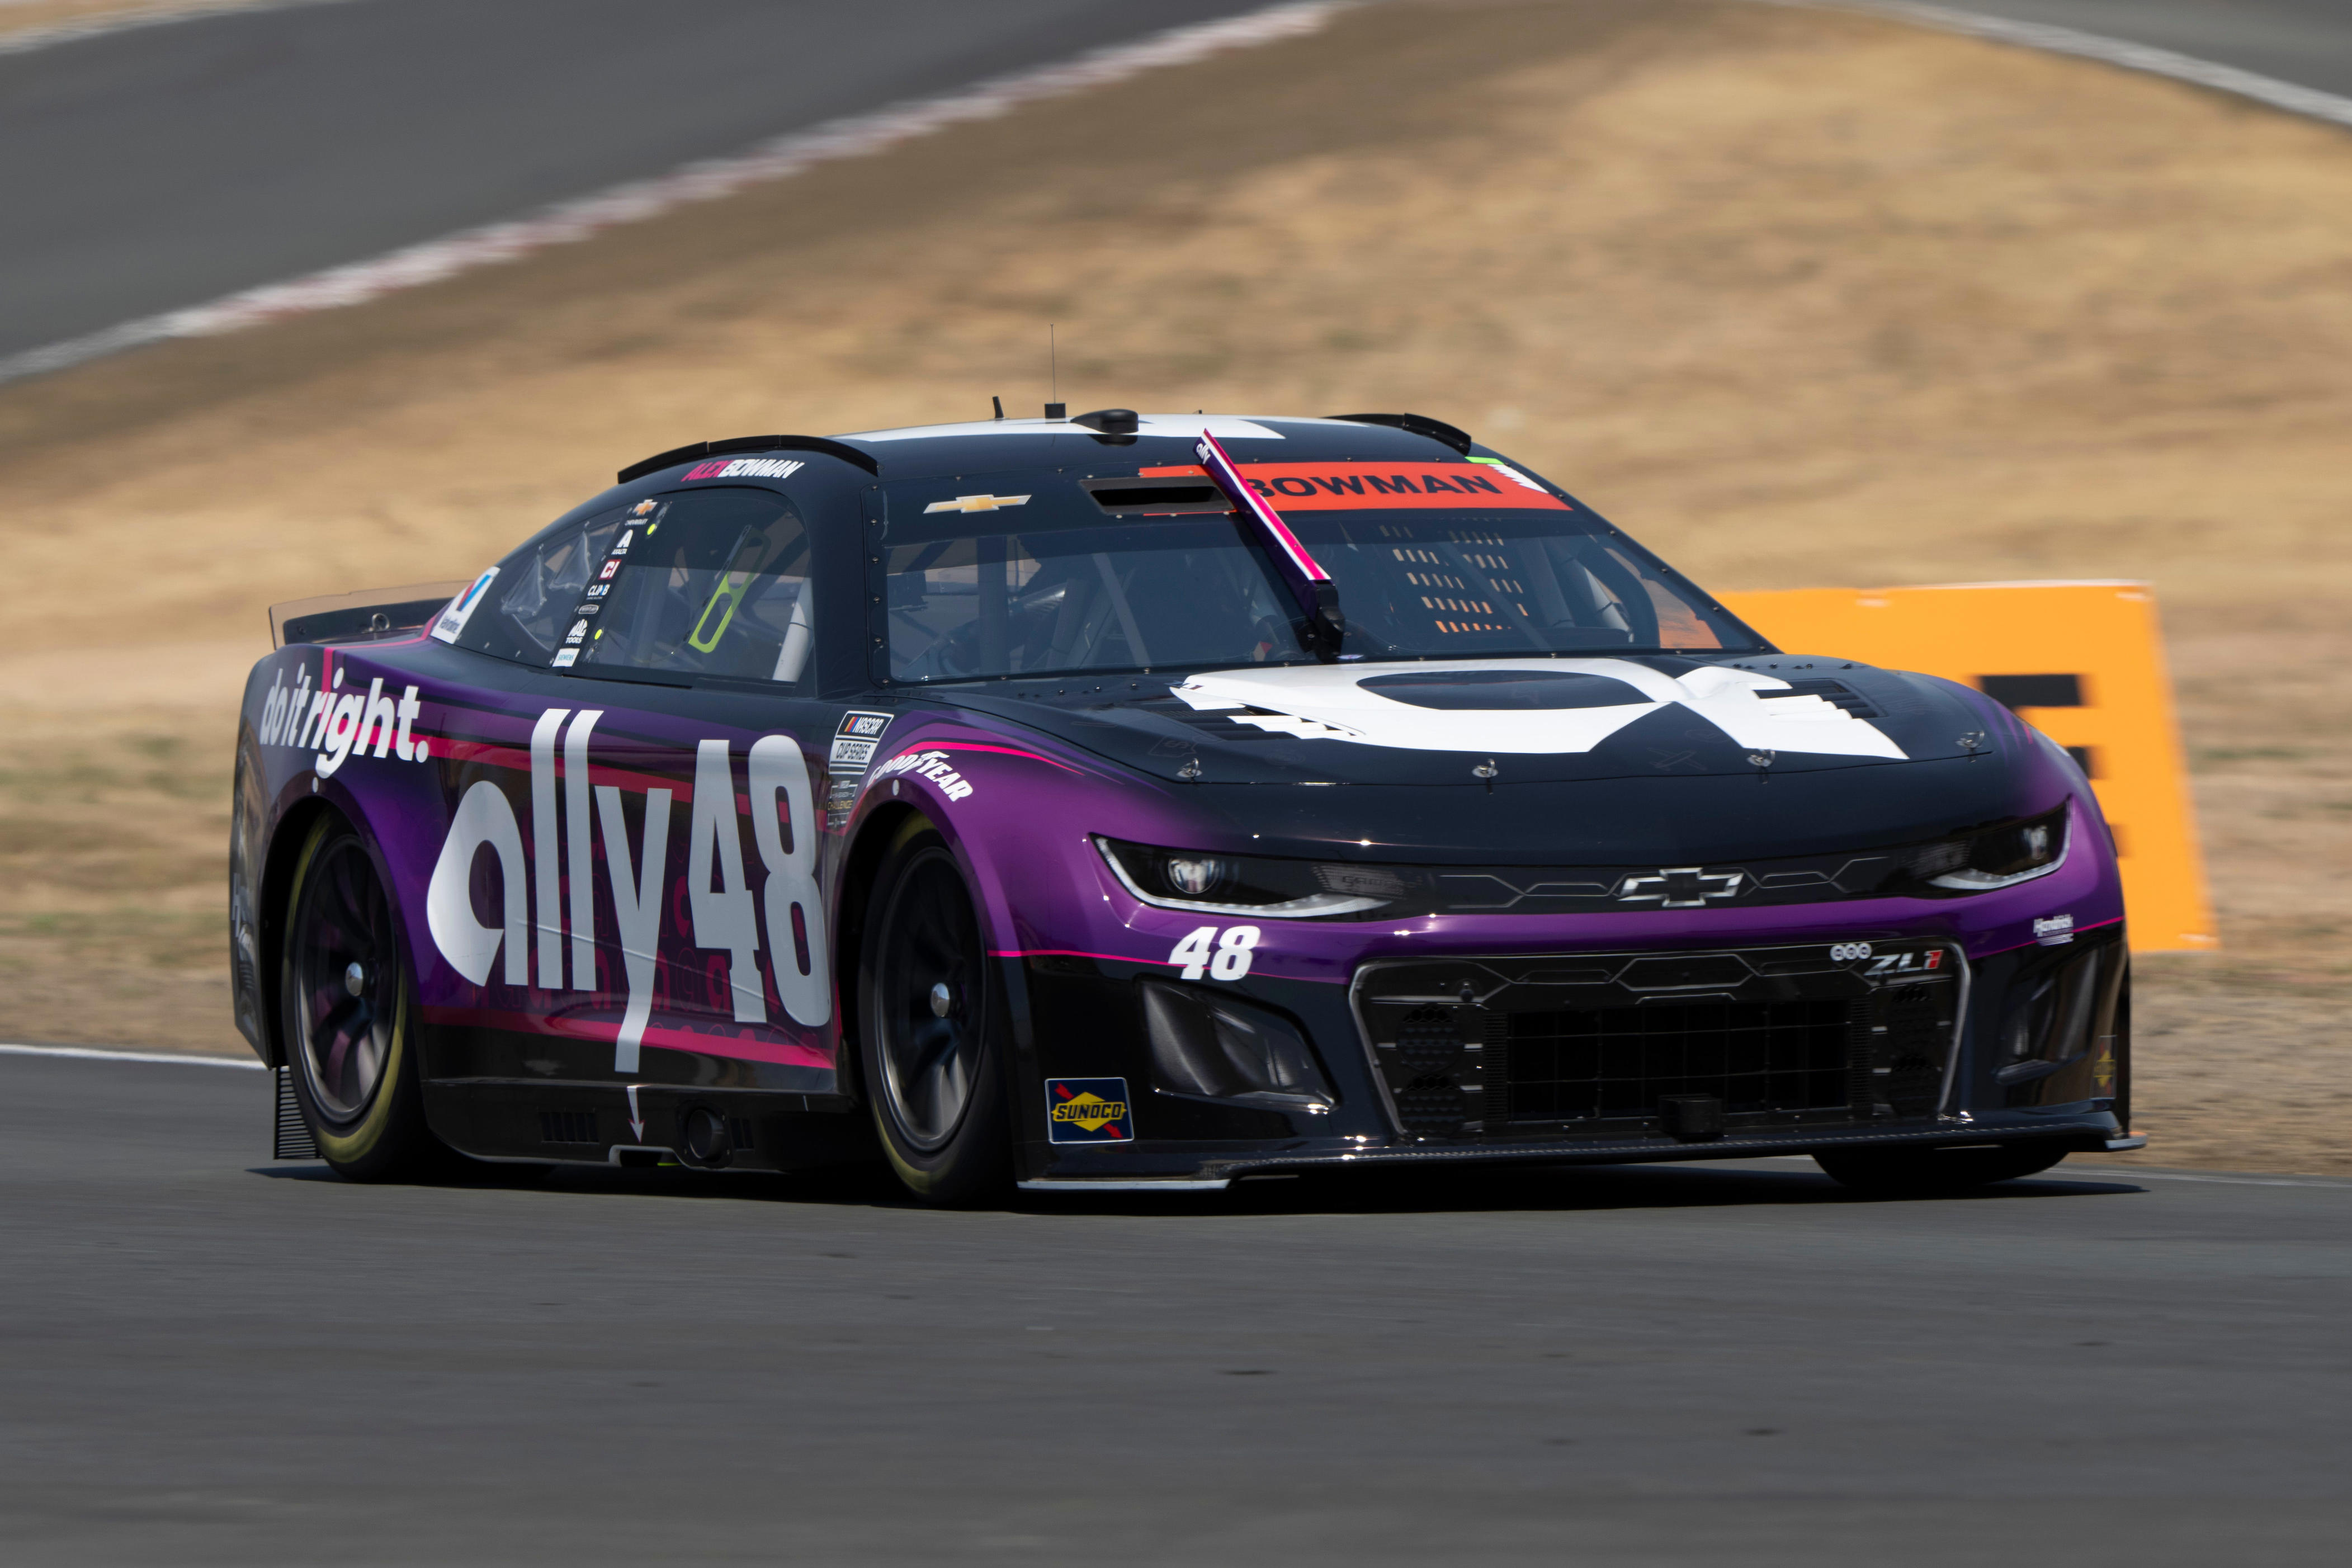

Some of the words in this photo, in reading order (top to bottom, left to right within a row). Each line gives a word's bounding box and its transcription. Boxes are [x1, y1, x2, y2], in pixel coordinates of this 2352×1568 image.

[1196, 443, 1211, 465] ally
[260, 668, 288, 746] do
[281, 663, 311, 747] it
[297, 667, 428, 779] right.
[852, 716, 885, 735] NASCAR
[836, 742, 851, 759] CUP
[848, 743, 871, 760] SERIES
[866, 751, 974, 802] GOODYEAR
[427, 708, 672, 1073] ally
[688, 734, 831, 1027] 48
[1168, 925, 1261, 980] 48
[1864, 950, 1944, 976] ZL1
[1056, 1103, 1125, 1120] SUNOCO
